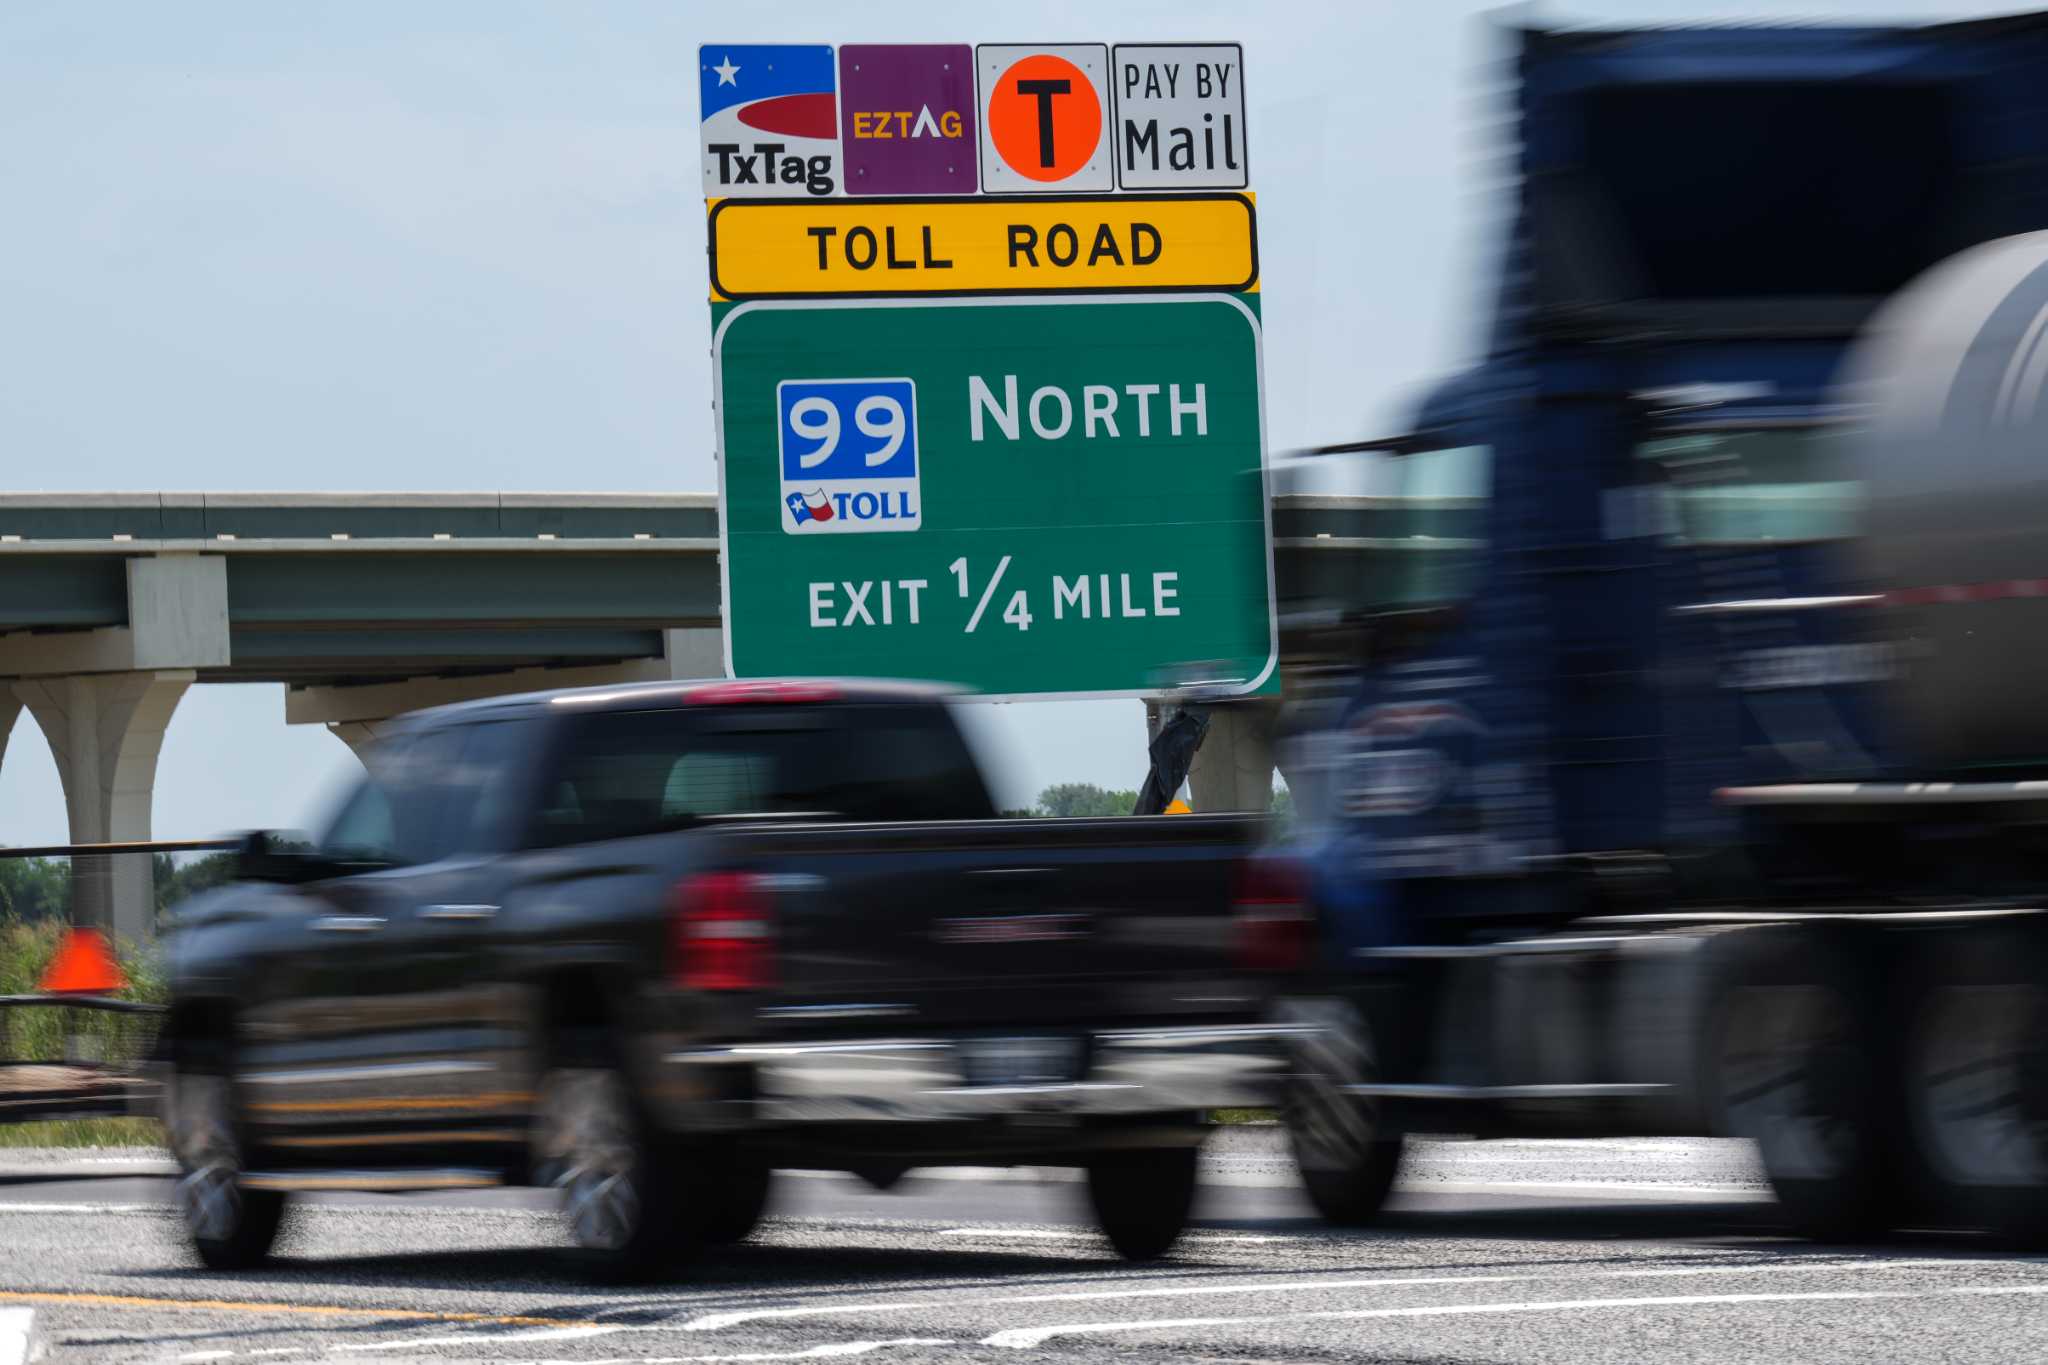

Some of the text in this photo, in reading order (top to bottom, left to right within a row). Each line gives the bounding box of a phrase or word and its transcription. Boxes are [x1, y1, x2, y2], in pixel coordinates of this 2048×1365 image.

[1125, 63, 1231, 99] PAY BY
[854, 103, 963, 139] EZTAG
[1017, 79, 1072, 168] T
[1125, 113, 1240, 171] Mail
[708, 143, 832, 195] TxTag
[808, 222, 1163, 270] TOLL ROAD
[789, 395, 906, 469] 99
[968, 375, 1209, 441] NORTH
[832, 491, 917, 520] TOLL
[809, 579, 928, 628] EXIT
[1052, 571, 1181, 620] MILE
